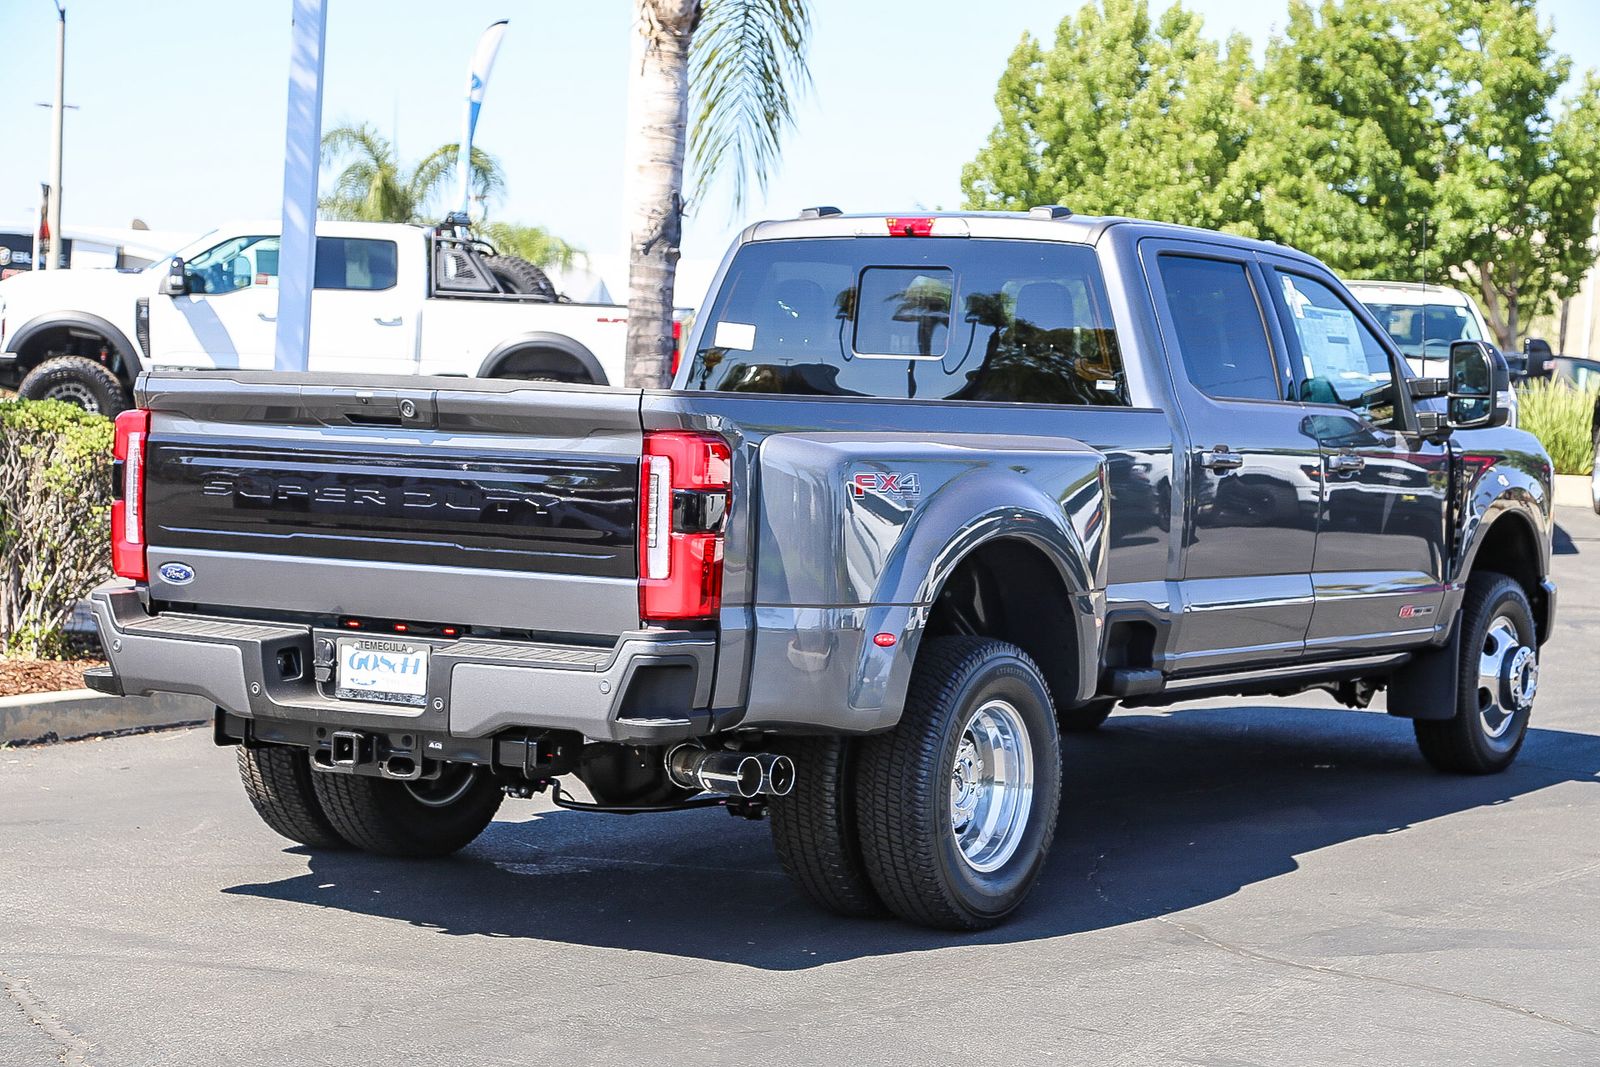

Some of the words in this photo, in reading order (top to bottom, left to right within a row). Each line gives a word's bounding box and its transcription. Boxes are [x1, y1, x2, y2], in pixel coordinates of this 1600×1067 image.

[203, 481, 387, 506] SUPER
[402, 492, 561, 515] DUTY
[359, 640, 408, 653] TEMECULA
